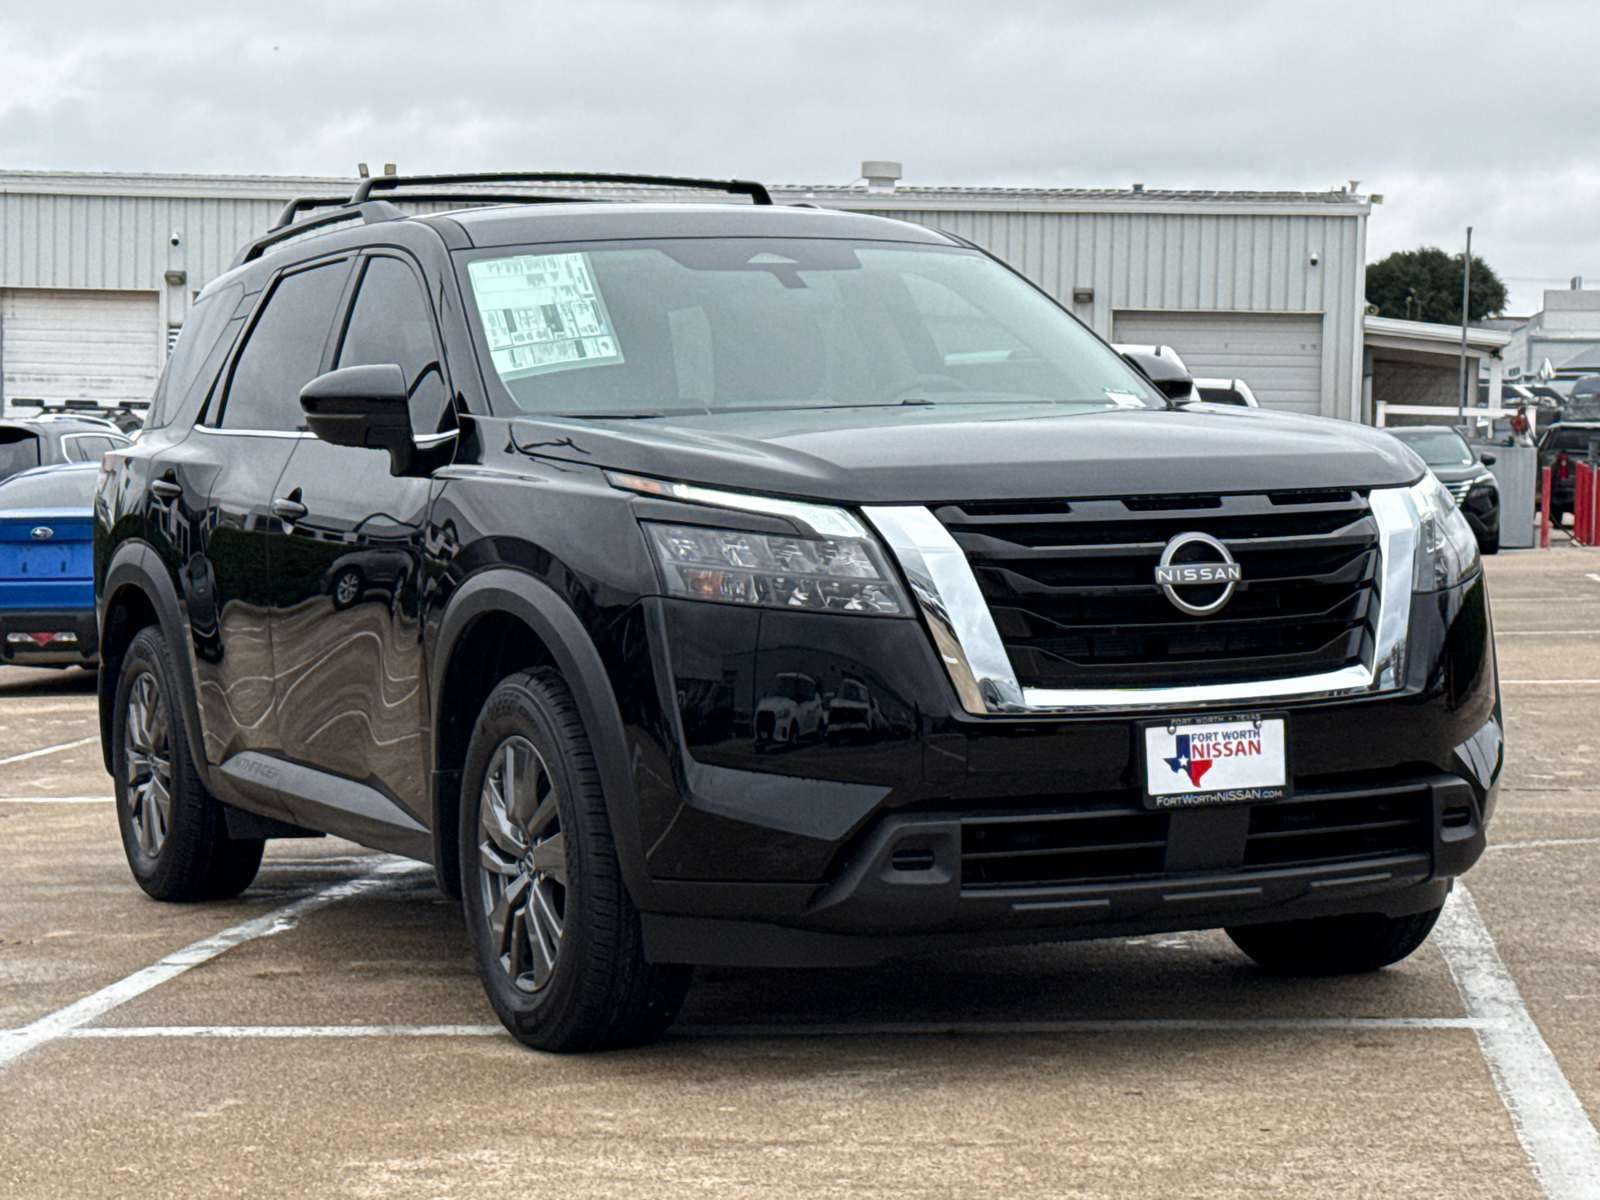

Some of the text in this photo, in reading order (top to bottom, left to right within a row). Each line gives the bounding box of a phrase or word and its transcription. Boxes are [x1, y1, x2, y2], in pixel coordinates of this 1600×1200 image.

[1158, 567, 1240, 582] NISSAN
[1191, 729, 1261, 743] FORT WORTH
[1191, 739, 1261, 759] NISSAN
